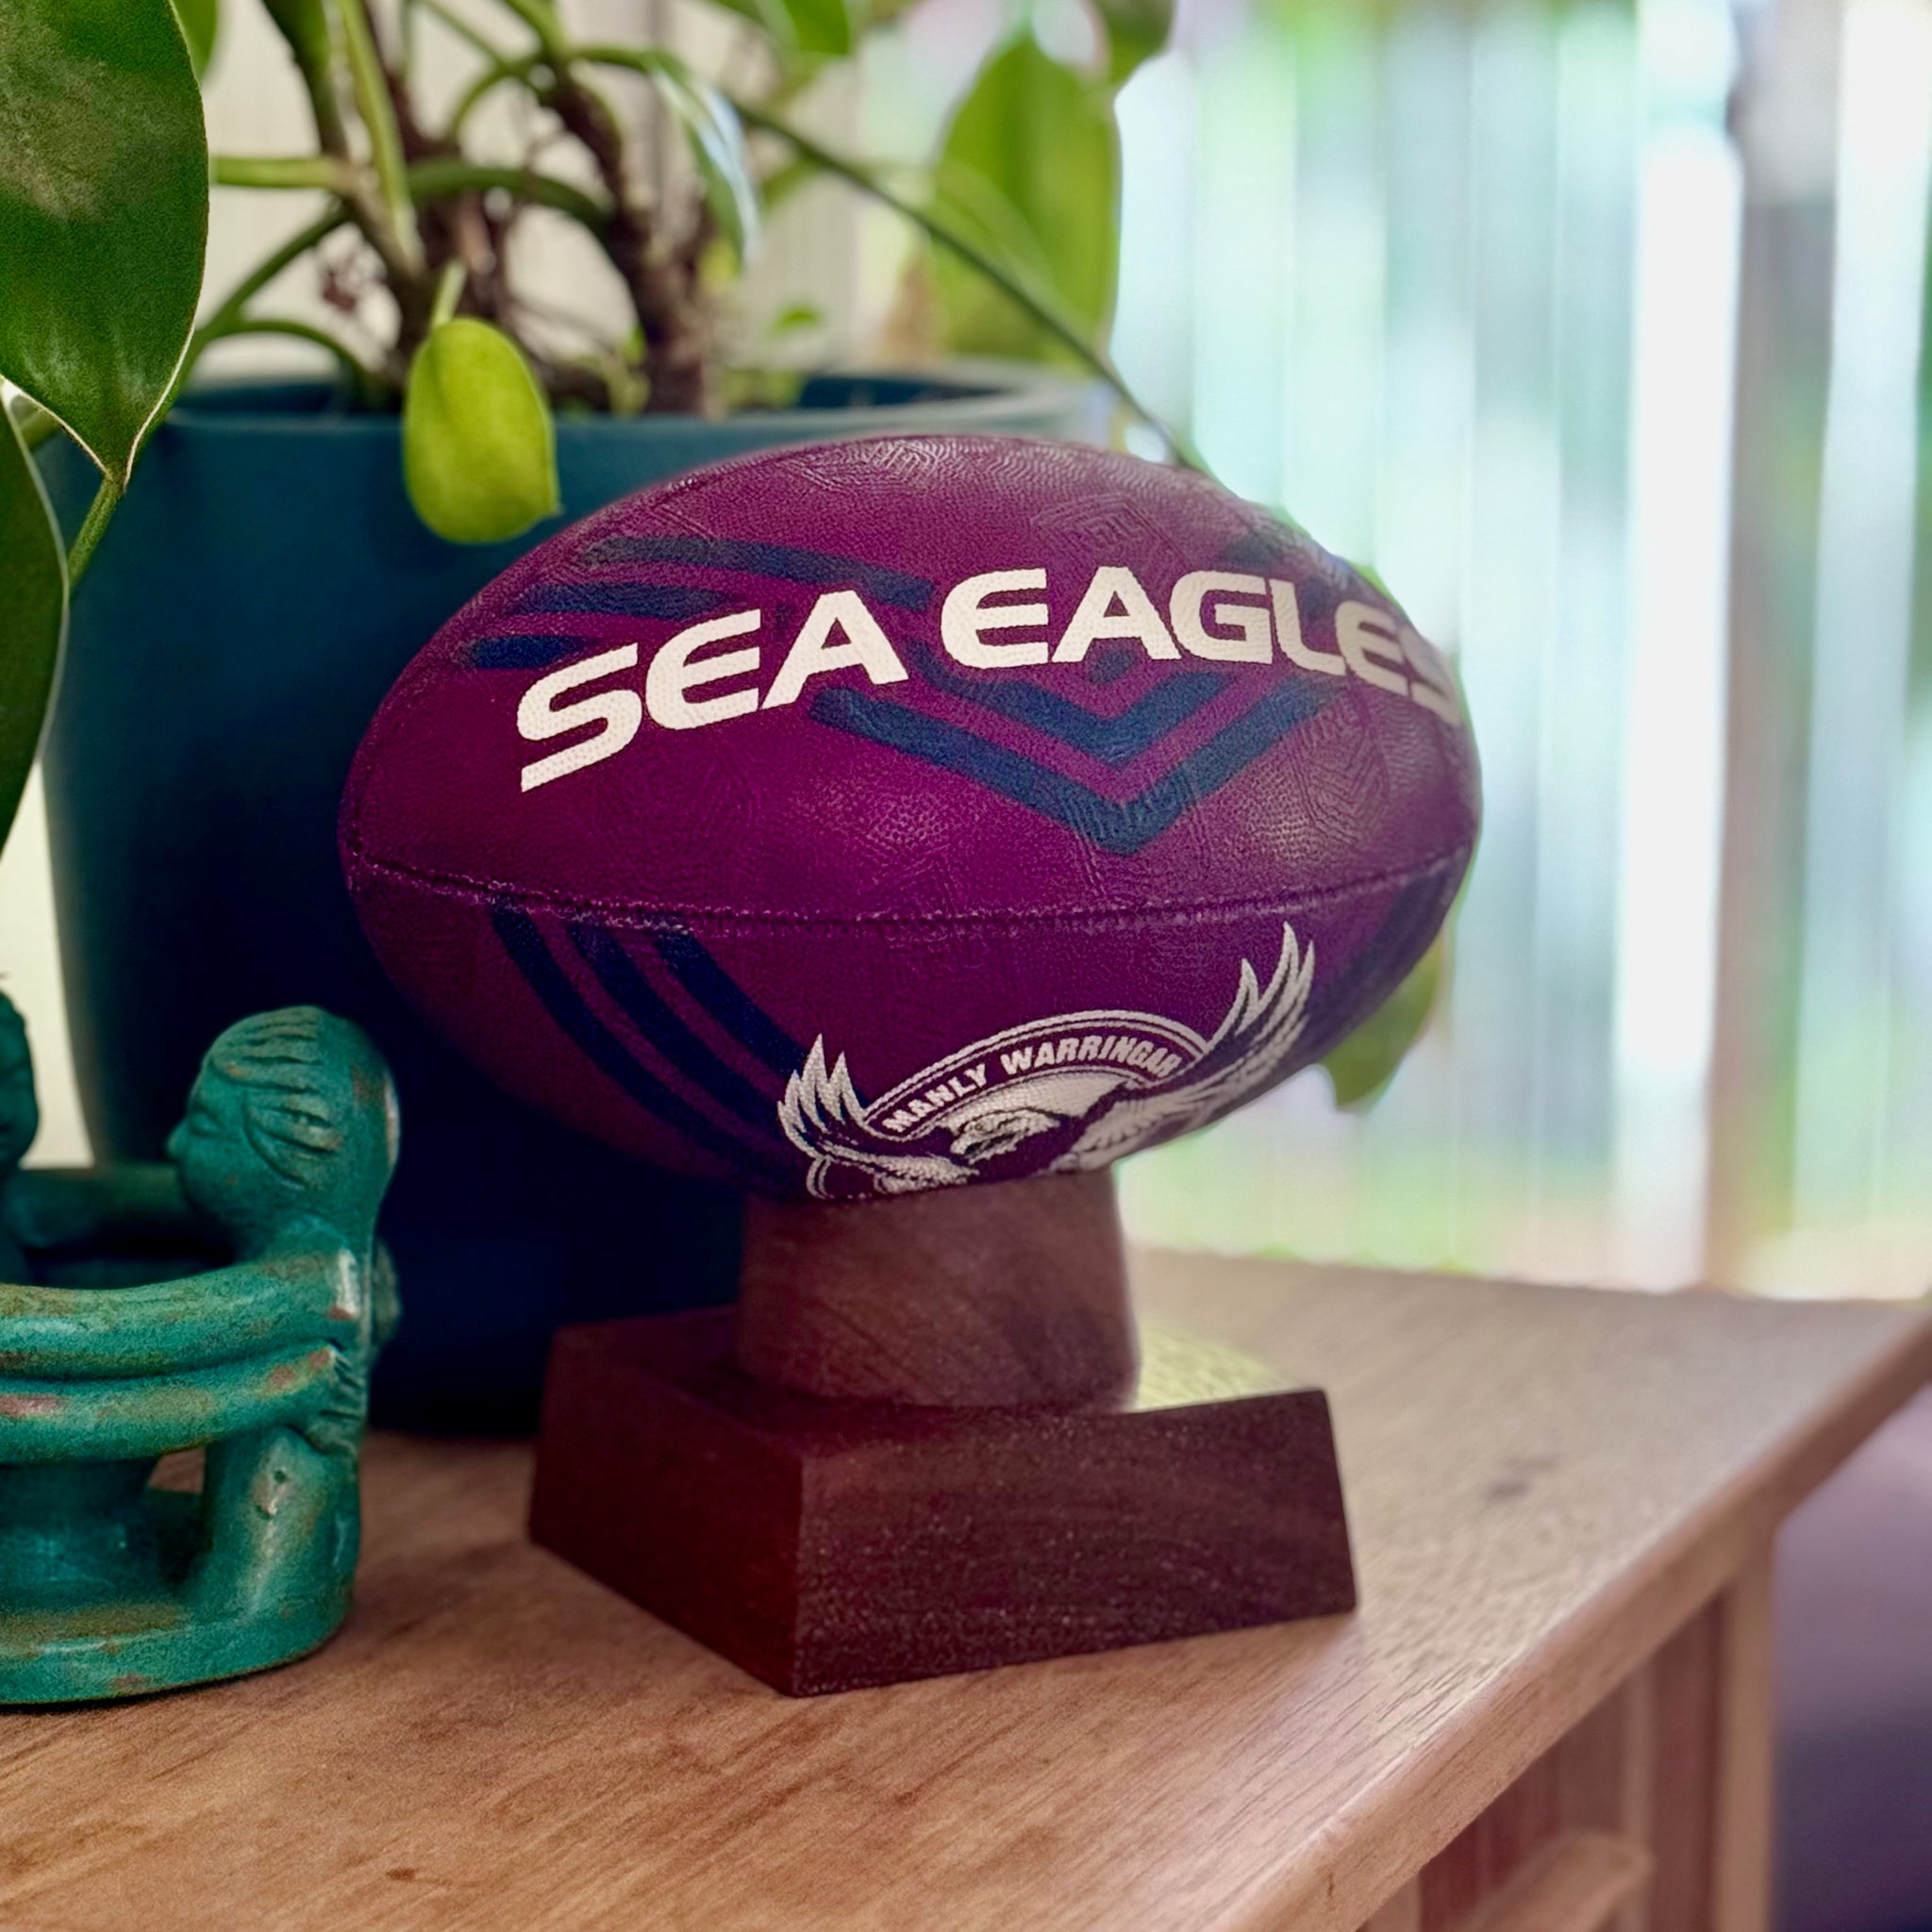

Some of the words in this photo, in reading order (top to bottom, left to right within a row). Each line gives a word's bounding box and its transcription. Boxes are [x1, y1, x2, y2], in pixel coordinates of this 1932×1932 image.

[516, 590, 909, 793] SEA
[941, 566, 1461, 726] EAGLES
[882, 1062, 988, 1133] MANLY
[1000, 1035, 1183, 1078] WARRINGAH
